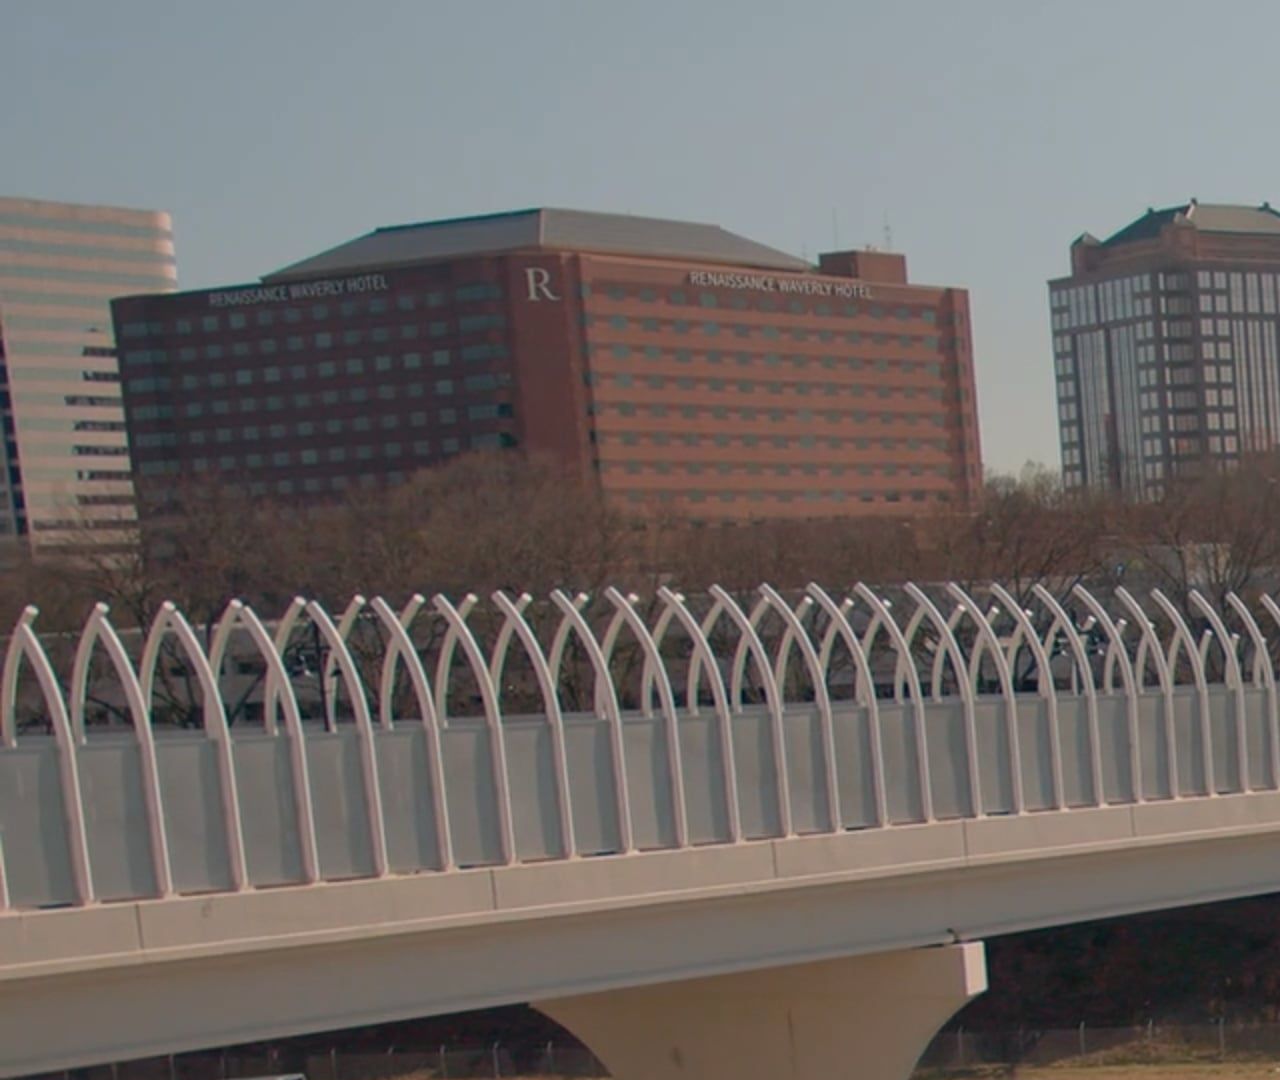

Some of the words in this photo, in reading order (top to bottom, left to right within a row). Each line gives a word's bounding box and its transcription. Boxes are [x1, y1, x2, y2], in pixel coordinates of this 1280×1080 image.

[209, 285, 287, 306] RENAISSANCE
[290, 281, 344, 299] WAVERLY
[347, 275, 387, 292] HOTEL
[523, 267, 560, 301] R
[690, 272, 775, 291] RENAISSANCE
[777, 279, 832, 297] WAVERLY
[834, 284, 873, 299] HOTEL
